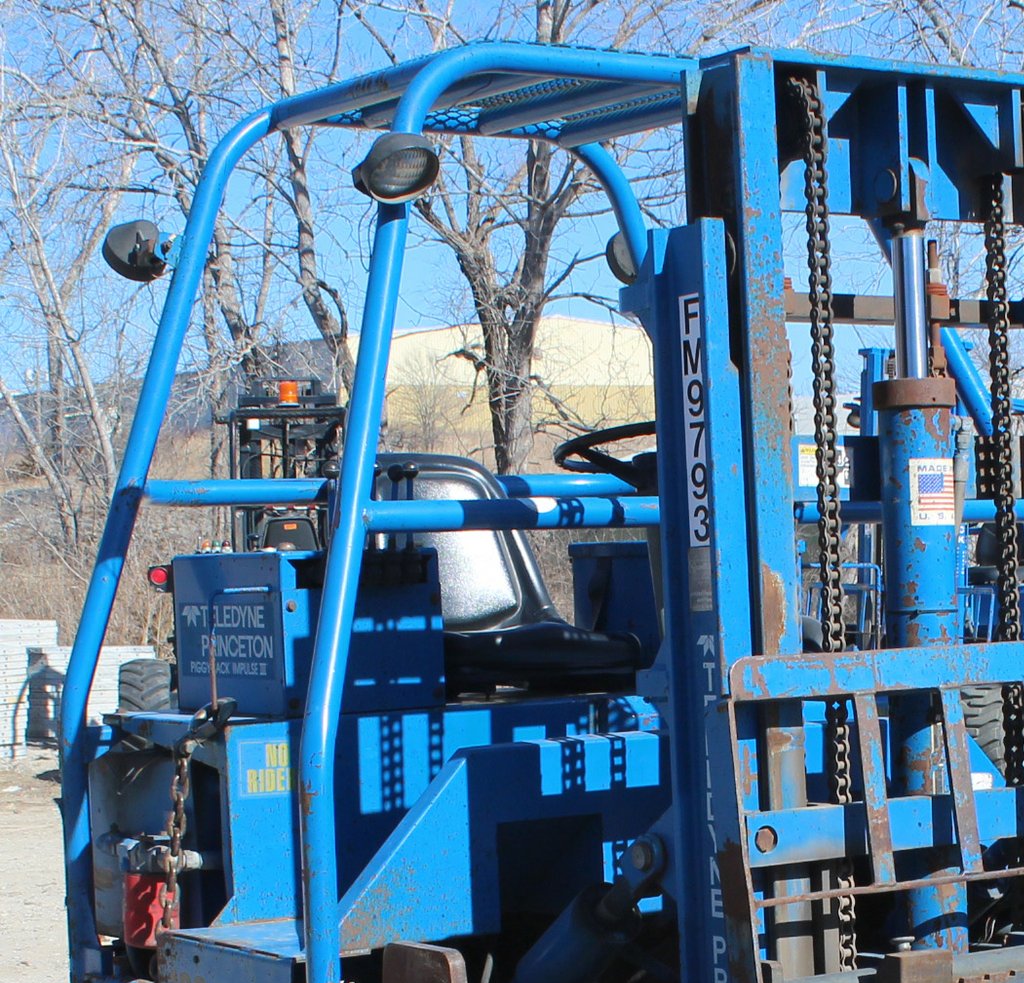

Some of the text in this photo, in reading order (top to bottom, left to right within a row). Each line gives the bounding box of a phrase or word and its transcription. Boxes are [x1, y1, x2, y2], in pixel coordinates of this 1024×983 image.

[682, 298, 709, 542] FM9793
[200, 605, 265, 628] TLEDYNE
[202, 635, 273, 659] PINCETON
[190, 661, 229, 675] PIGGACK
[266, 744, 289, 768] NO
